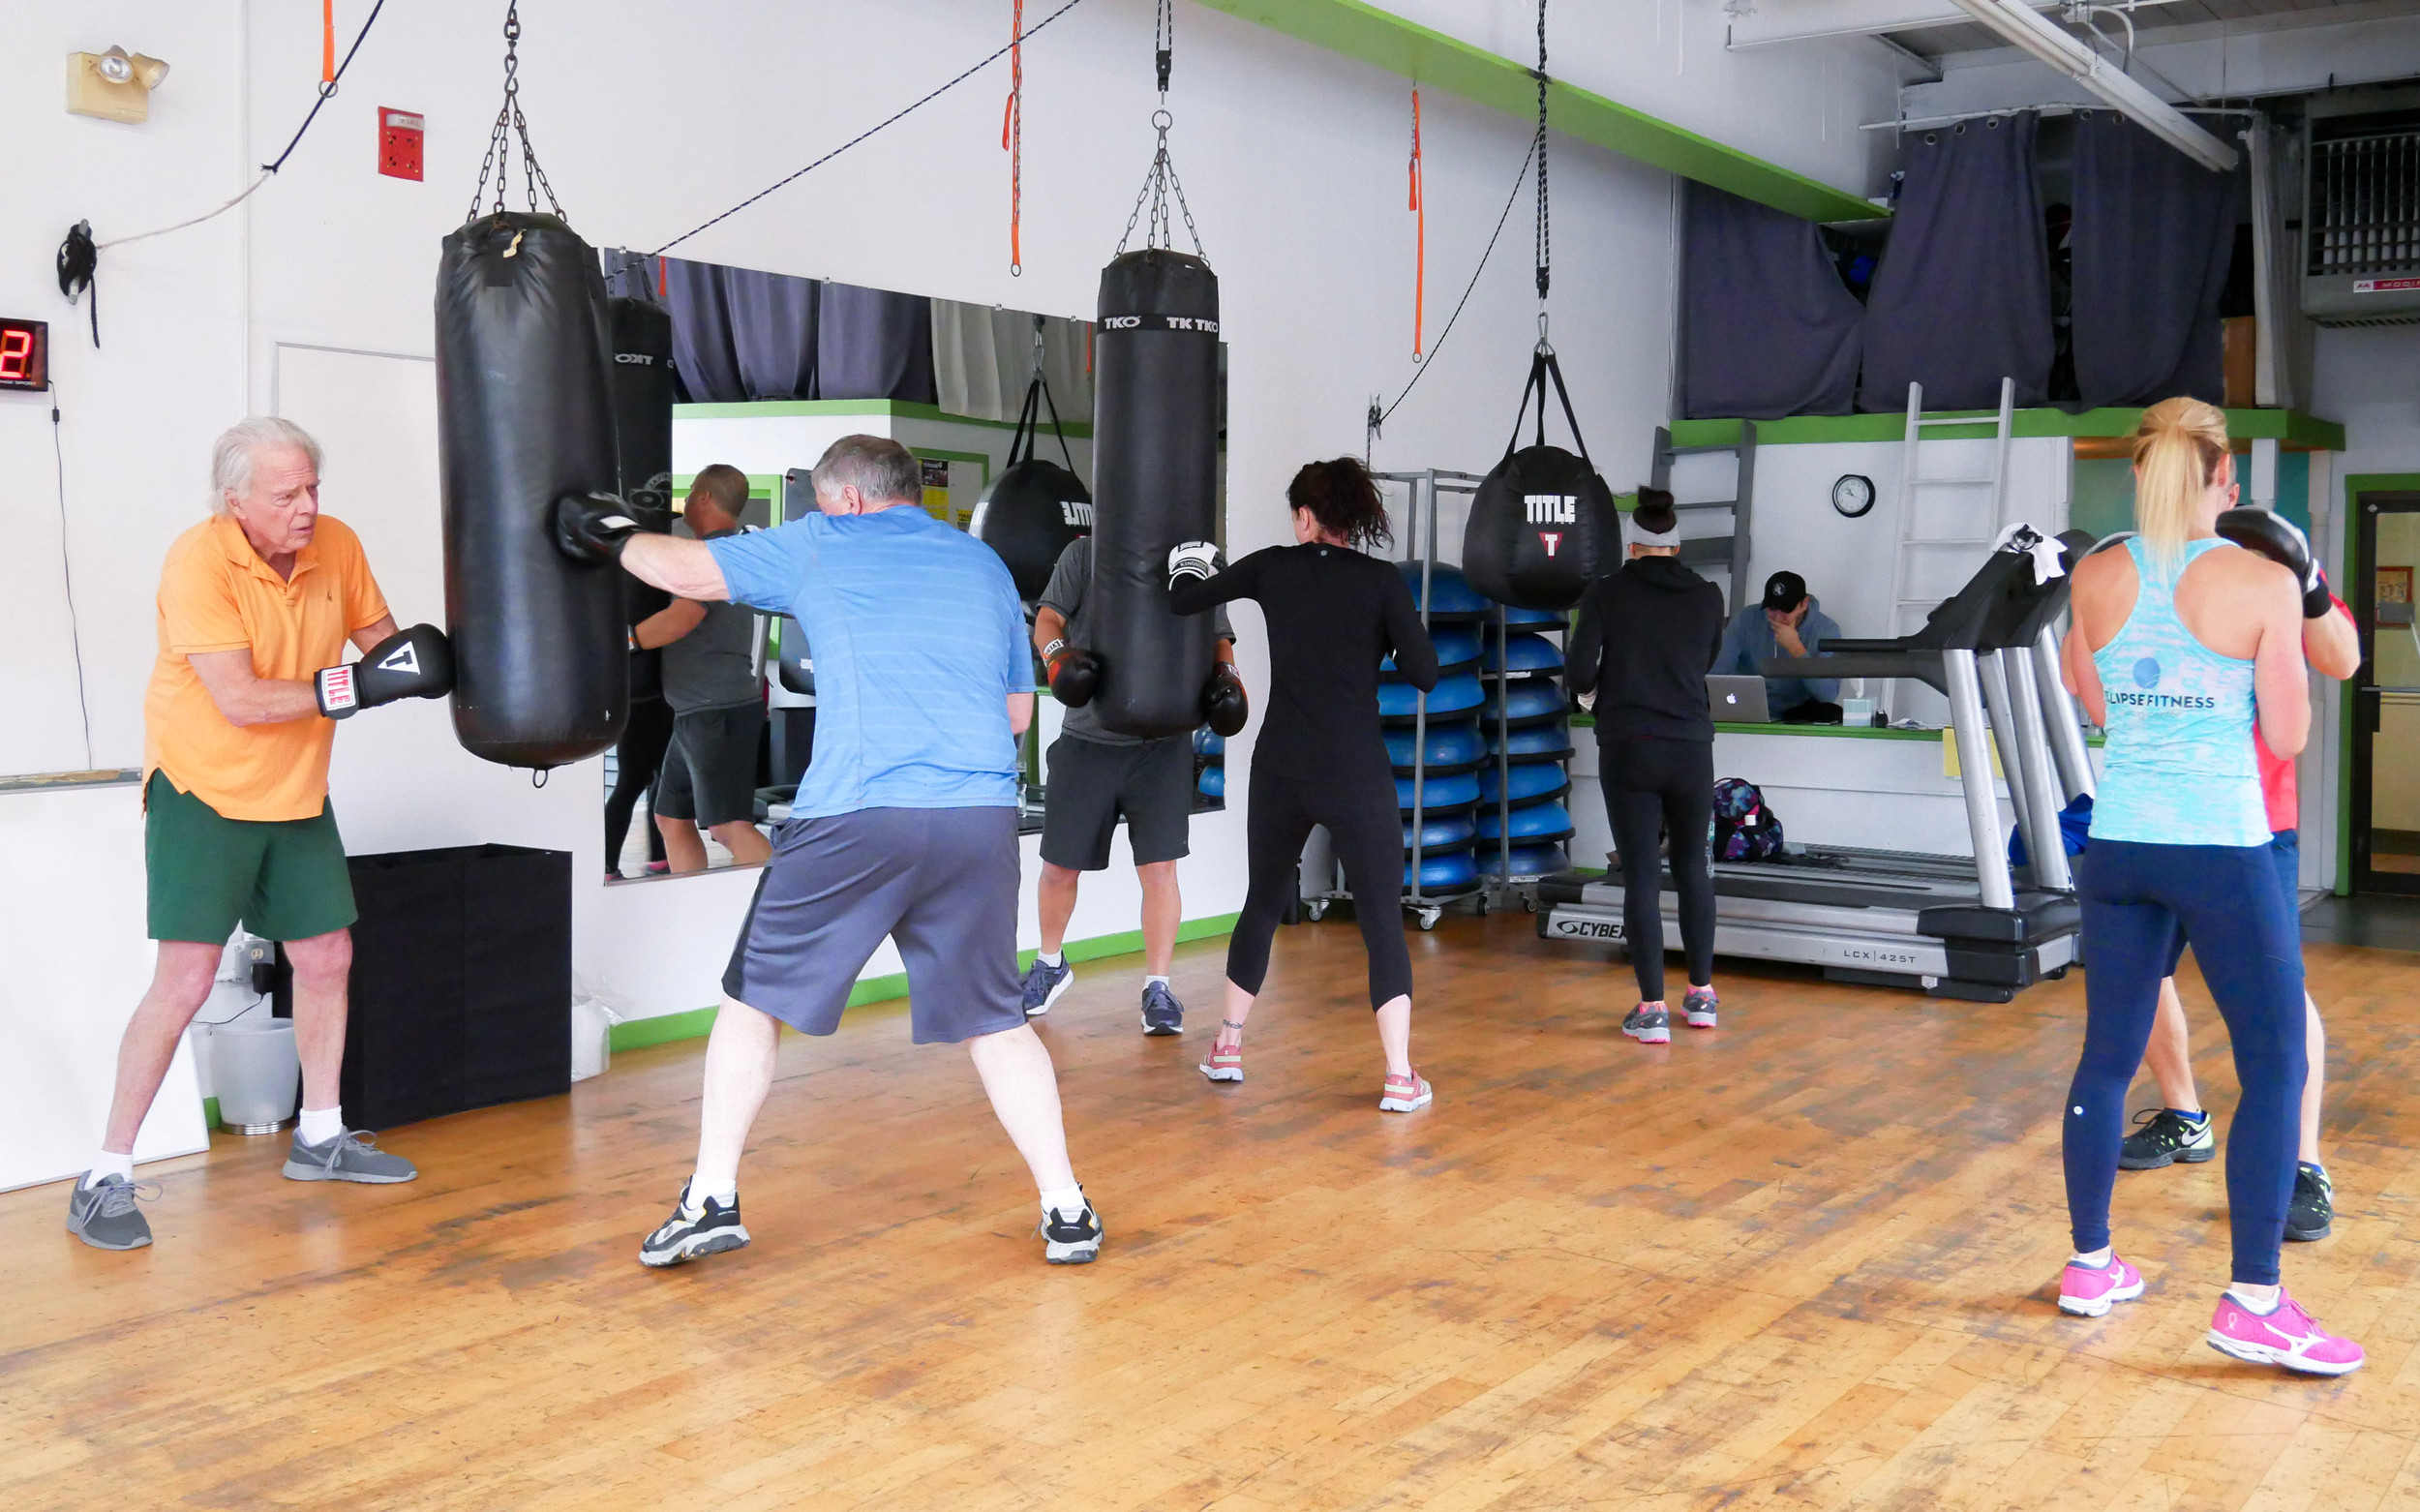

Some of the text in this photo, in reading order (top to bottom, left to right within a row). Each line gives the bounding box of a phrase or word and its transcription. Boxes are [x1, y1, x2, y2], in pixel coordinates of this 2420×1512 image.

[1104, 316, 1141, 330] TKO
[1195, 318, 1218, 334] TKO
[0, 329, 31, 378] 2
[1525, 495, 1575, 523] TITLE
[1545, 533, 1558, 557] T
[385, 650, 413, 668] T
[327, 668, 351, 706] TITLE
[1844, 950, 1916, 963] LCX 425T
